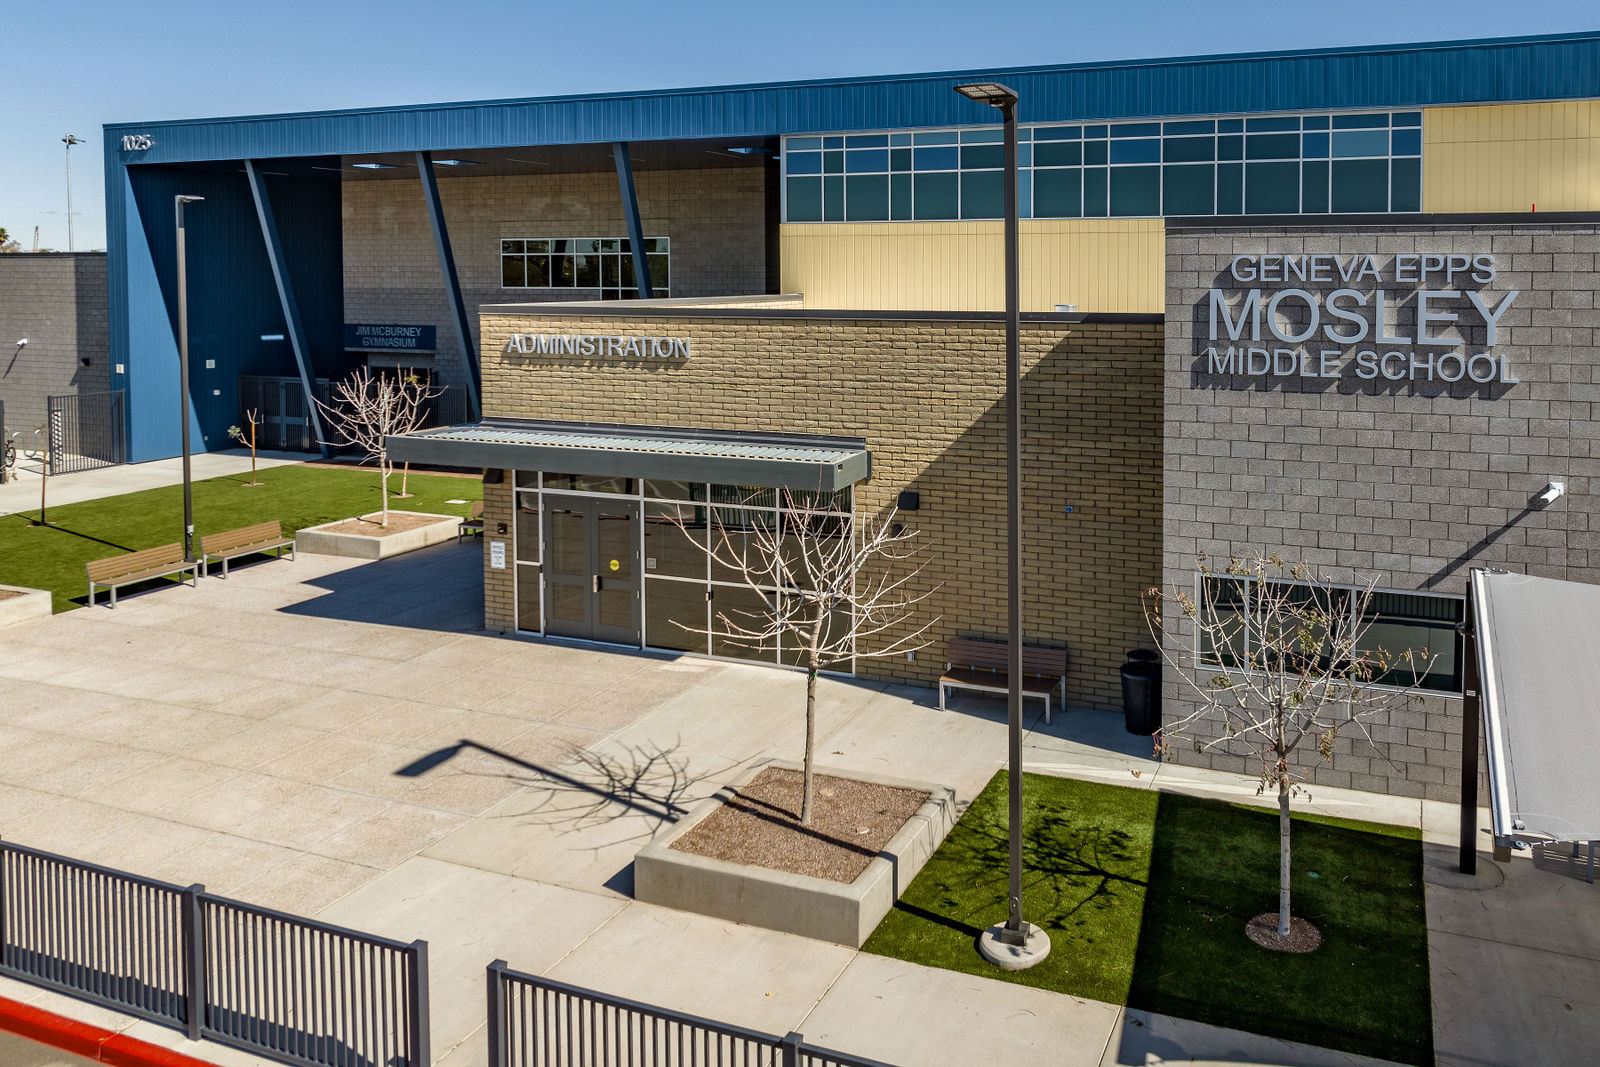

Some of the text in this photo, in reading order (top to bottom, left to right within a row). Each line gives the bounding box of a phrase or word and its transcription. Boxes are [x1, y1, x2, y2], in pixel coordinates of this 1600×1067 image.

[121, 134, 151, 151] 1025
[1231, 254, 1496, 283] GENEVA EPPS
[1209, 288, 1520, 346] MOSLEY
[355, 326, 422, 337] JIM MCBURNEY
[362, 337, 416, 348] GYMNASIUM
[507, 333, 691, 359] ADMINISTRATION
[1208, 347, 1520, 384] MIDDLE SCHOOL
